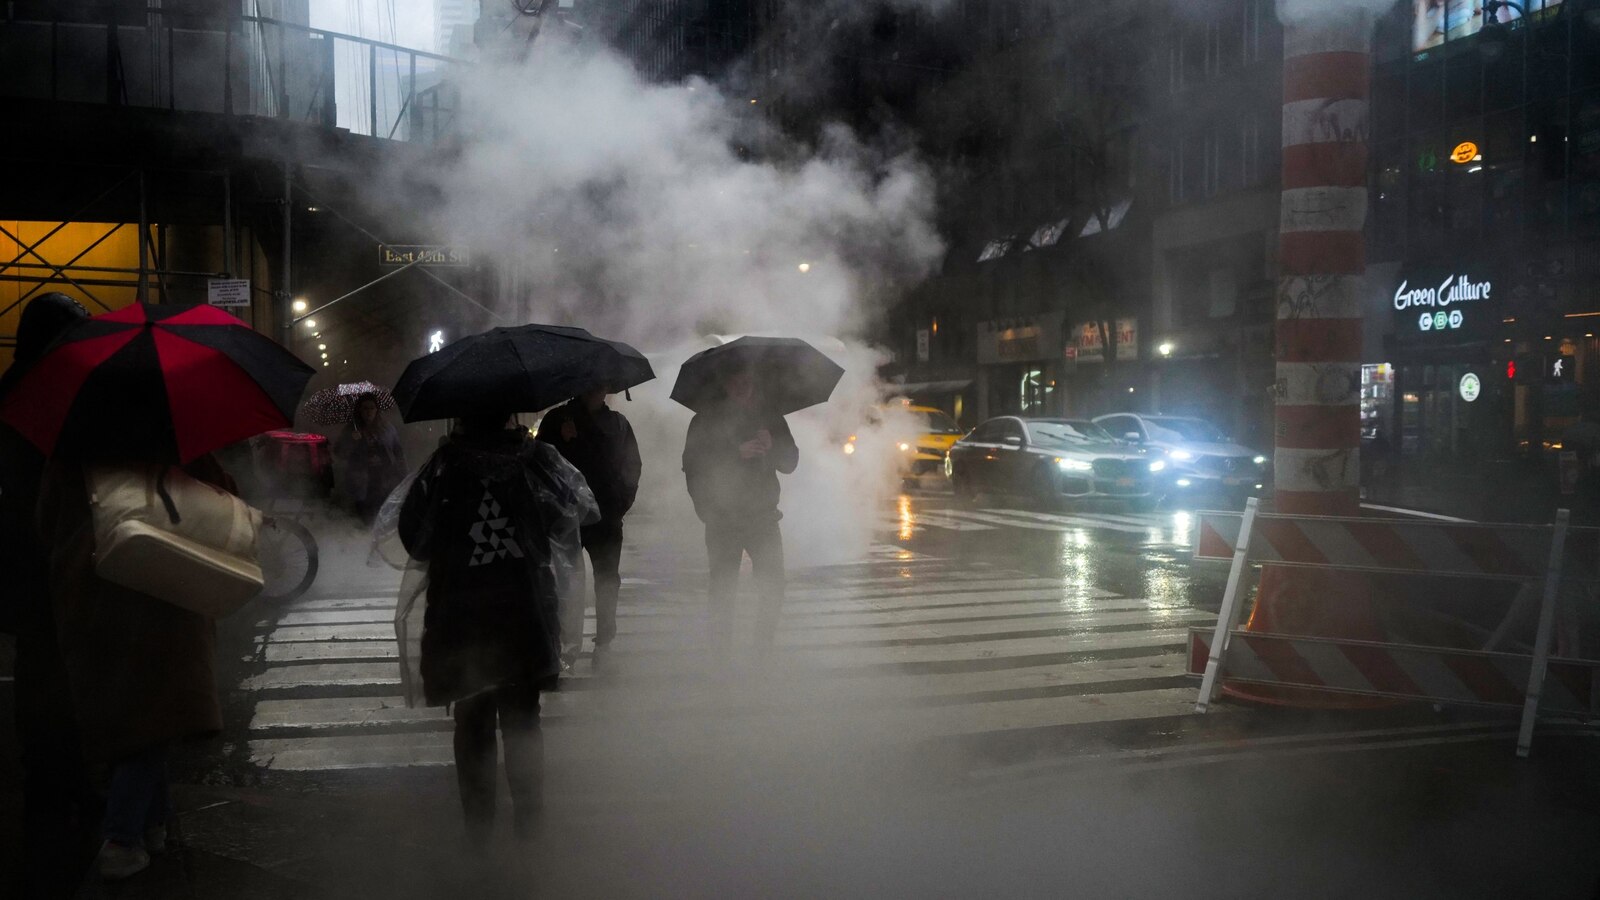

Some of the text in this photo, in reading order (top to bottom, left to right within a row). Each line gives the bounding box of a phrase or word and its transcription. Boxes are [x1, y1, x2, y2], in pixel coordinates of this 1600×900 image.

[385, 250, 413, 262] East
[1394, 274, 1491, 310] Green Culture
[1420, 311, 1462, 330] CBD
